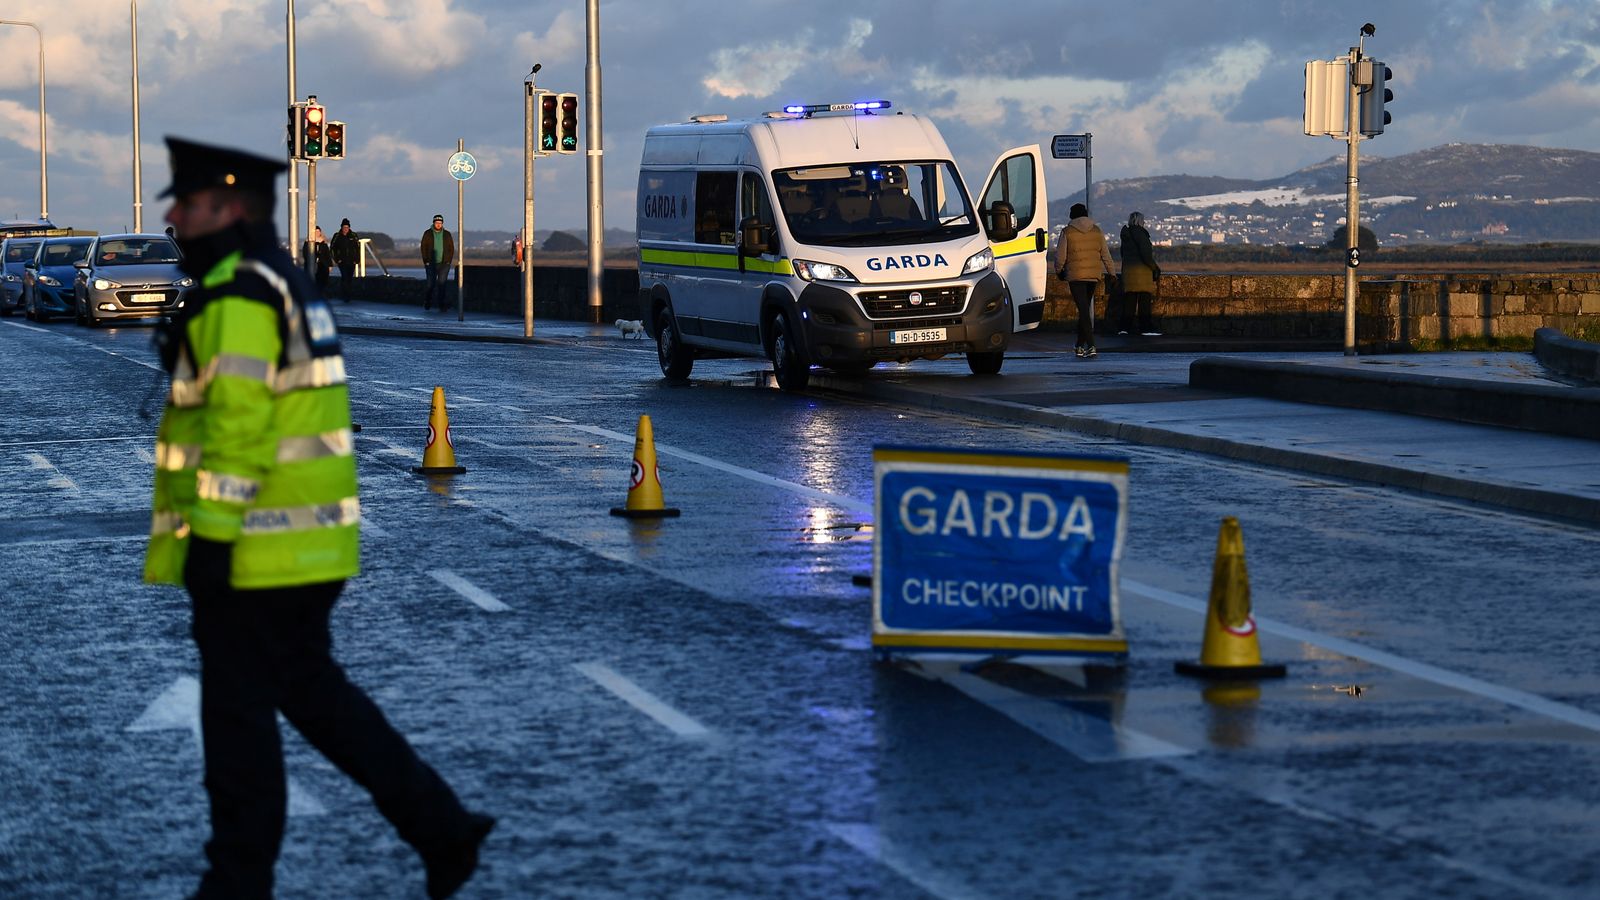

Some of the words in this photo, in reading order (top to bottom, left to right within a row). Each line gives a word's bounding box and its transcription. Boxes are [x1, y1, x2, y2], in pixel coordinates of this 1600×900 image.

[644, 194, 677, 219] GARDA
[866, 253, 949, 271] GARDA
[899, 486, 1095, 541] GARDA
[902, 578, 1088, 612] CHECKPOINT
